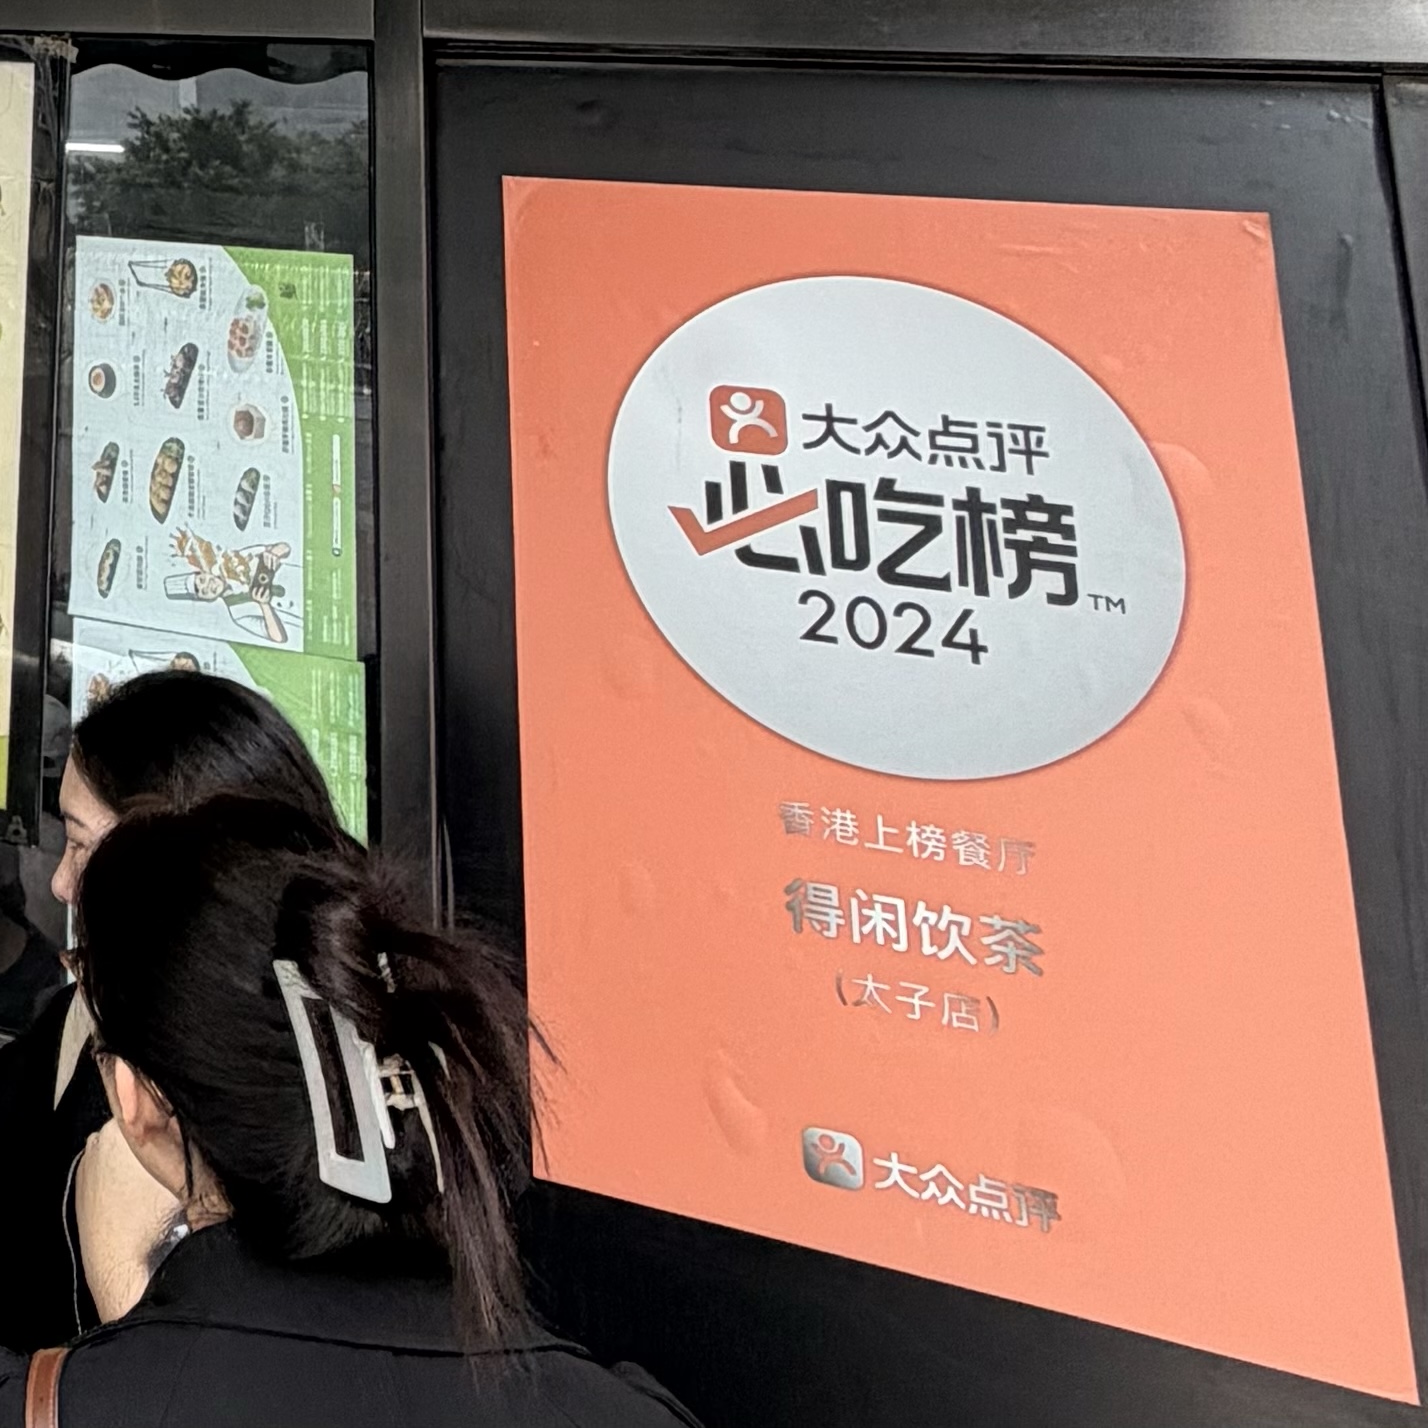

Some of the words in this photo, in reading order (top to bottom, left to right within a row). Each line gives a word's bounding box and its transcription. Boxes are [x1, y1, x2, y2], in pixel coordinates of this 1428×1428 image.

[800, 401, 1051, 477] 大众点评
[668, 459, 1080, 608] 必吃榜
[797, 587, 990, 666] 2024
[778, 799, 1036, 876] 香港上榜餐厅
[782, 877, 1046, 978] 得闲饮茶
[872, 1150, 1062, 1234] 大众点评
